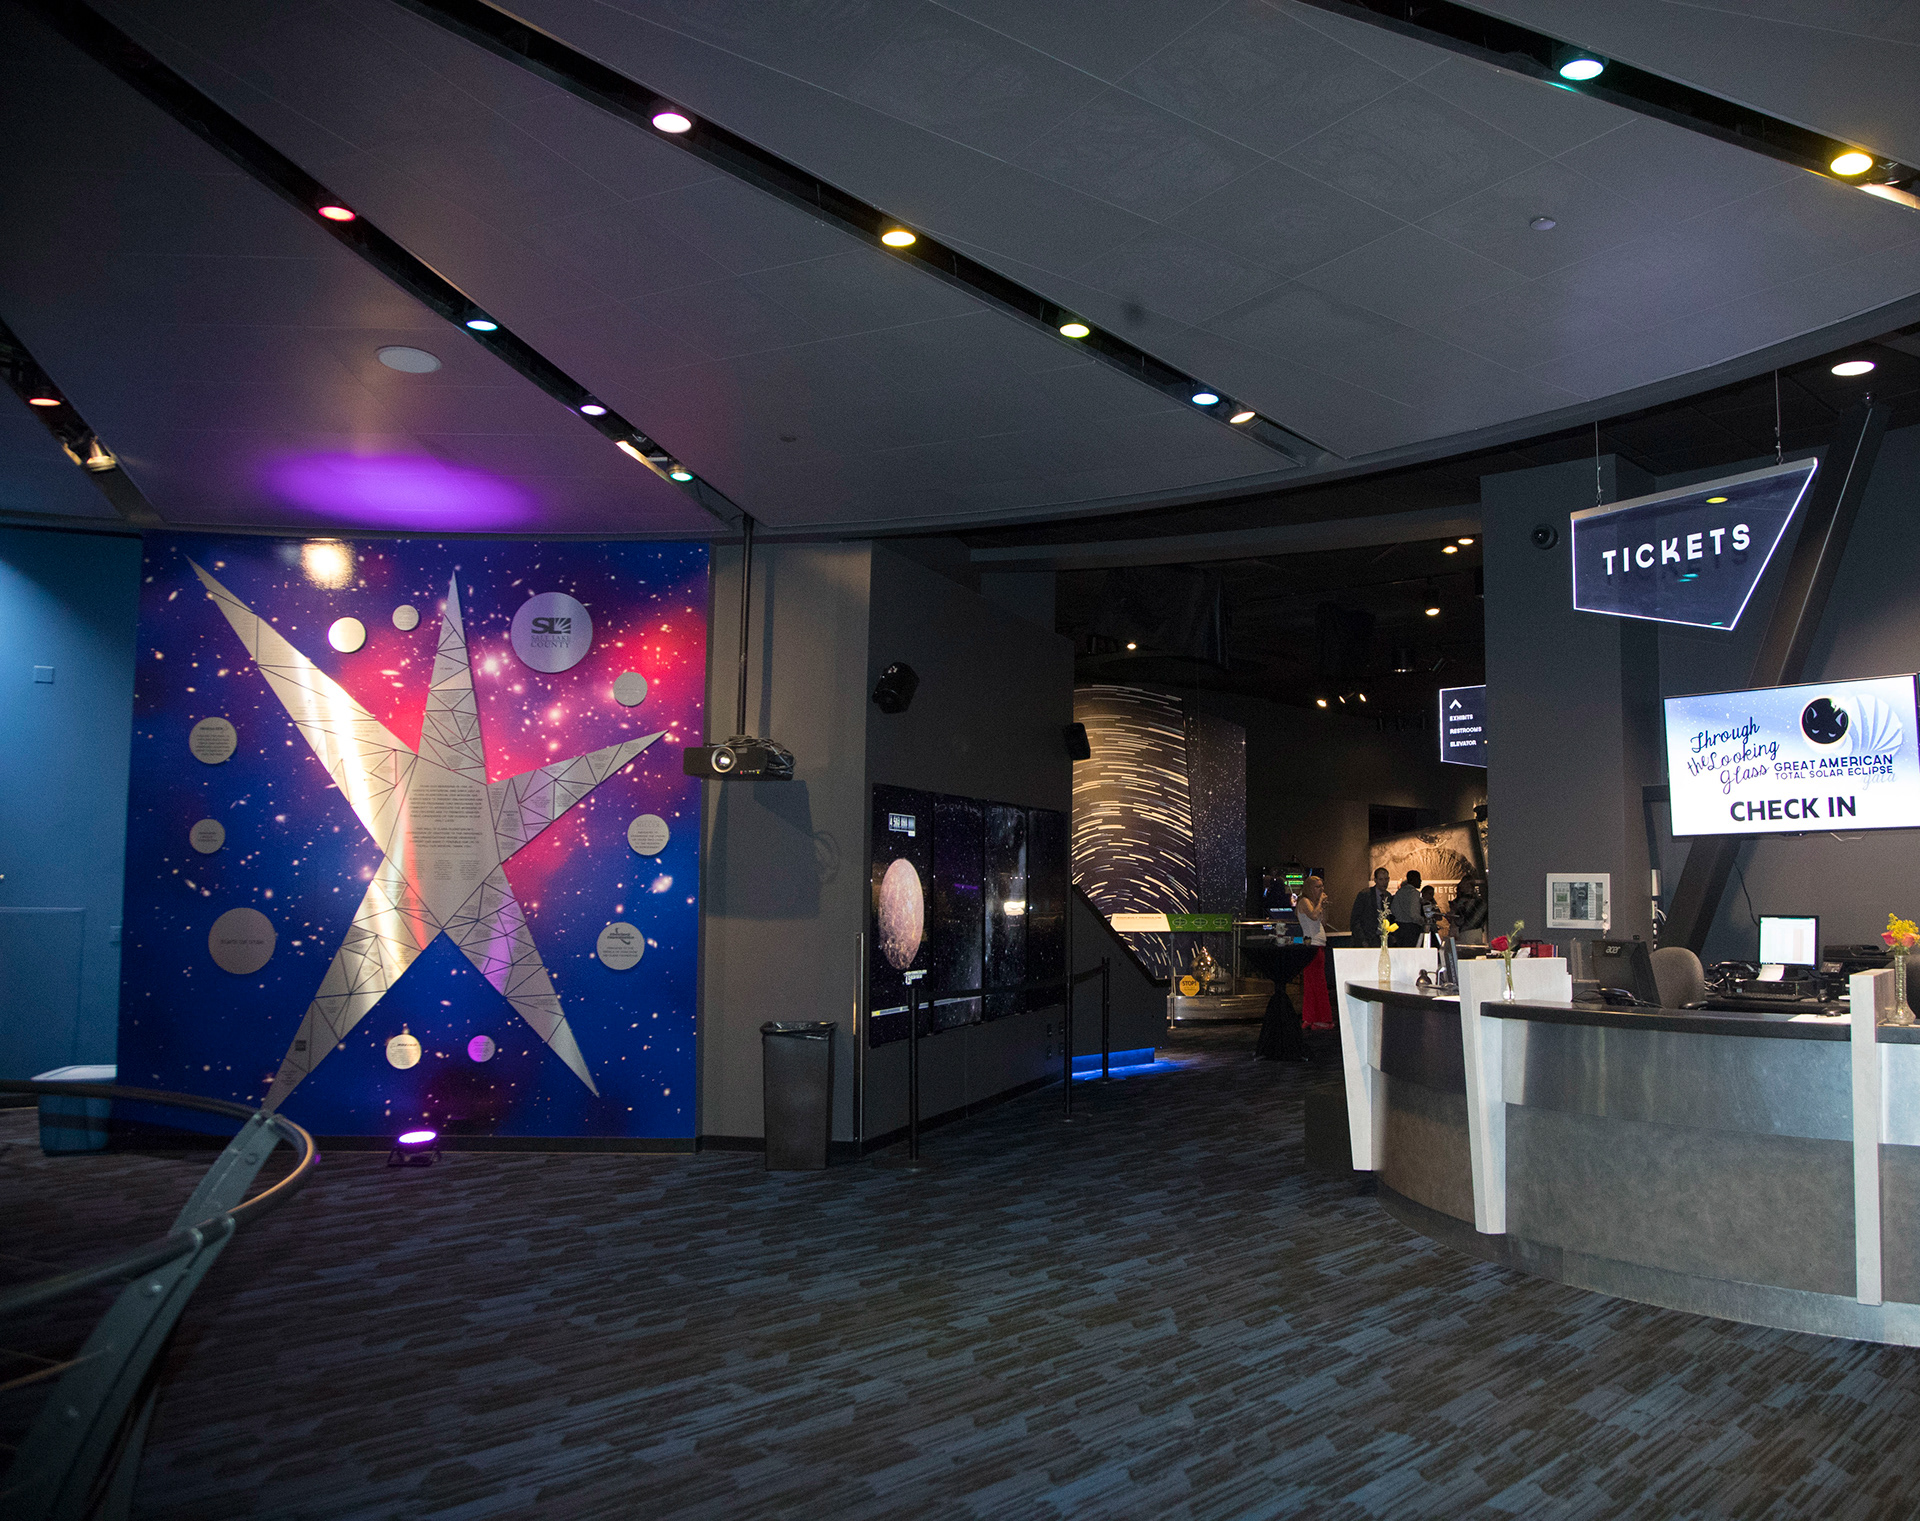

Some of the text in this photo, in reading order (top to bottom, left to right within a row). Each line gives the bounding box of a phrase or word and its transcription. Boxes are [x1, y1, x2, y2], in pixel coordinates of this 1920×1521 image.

[1602, 524, 1751, 575] TICKETS
[1449, 726, 1482, 735] RESTROOMS
[1690, 716, 1760, 754] Through
[1687, 740, 1780, 777] the Looking
[1773, 754, 1893, 772] GREAT AMERICAN
[1775, 765, 1893, 780] TOTAL SOLAR ECLIPSE
[1730, 796, 1857, 822] CHECK IN
[1605, 946, 1621, 954] acer
